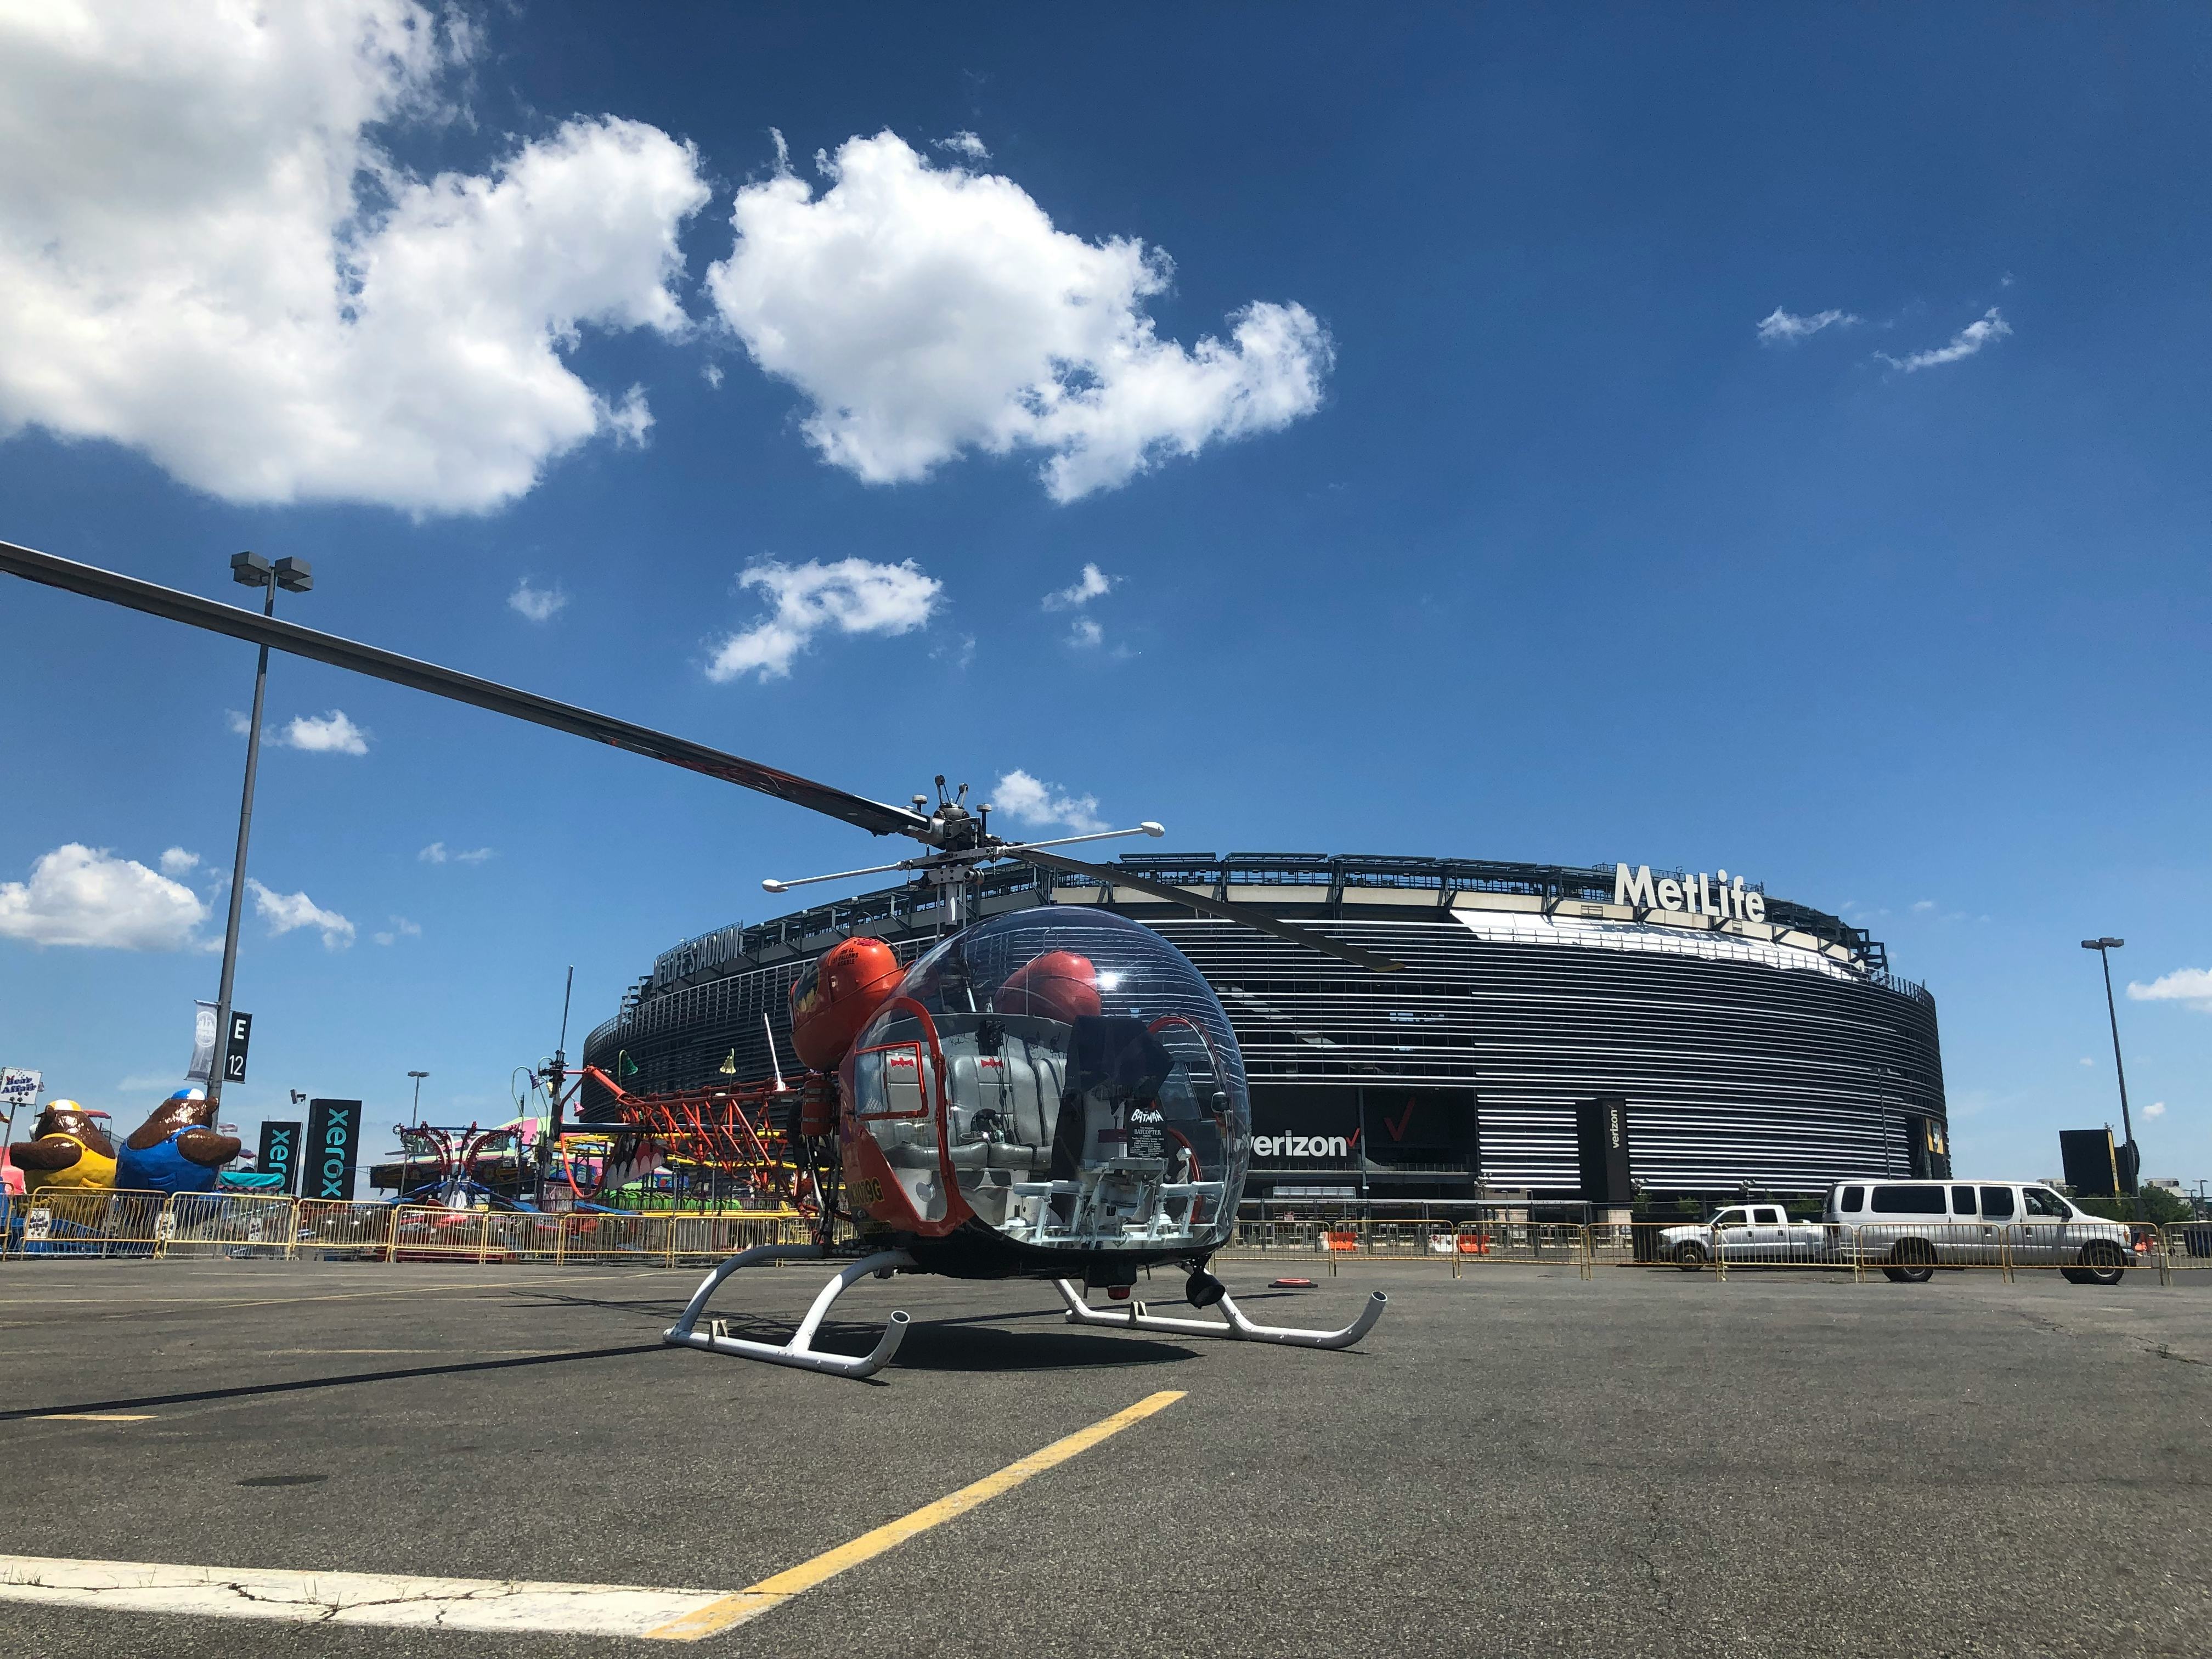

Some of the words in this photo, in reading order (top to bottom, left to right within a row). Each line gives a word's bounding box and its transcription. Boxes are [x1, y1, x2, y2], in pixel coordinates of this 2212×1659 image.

[1614, 862, 1765, 923] MetLife
[689, 927, 738, 974] STADIUM
[234, 1019, 246, 1040] E
[229, 1054, 244, 1076] 12
[1131, 1109, 1164, 1123] BATMAN
[1610, 1109, 1620, 1148] verizon
[269, 1129, 290, 1195] xer
[321, 1108, 348, 1197] xerox
